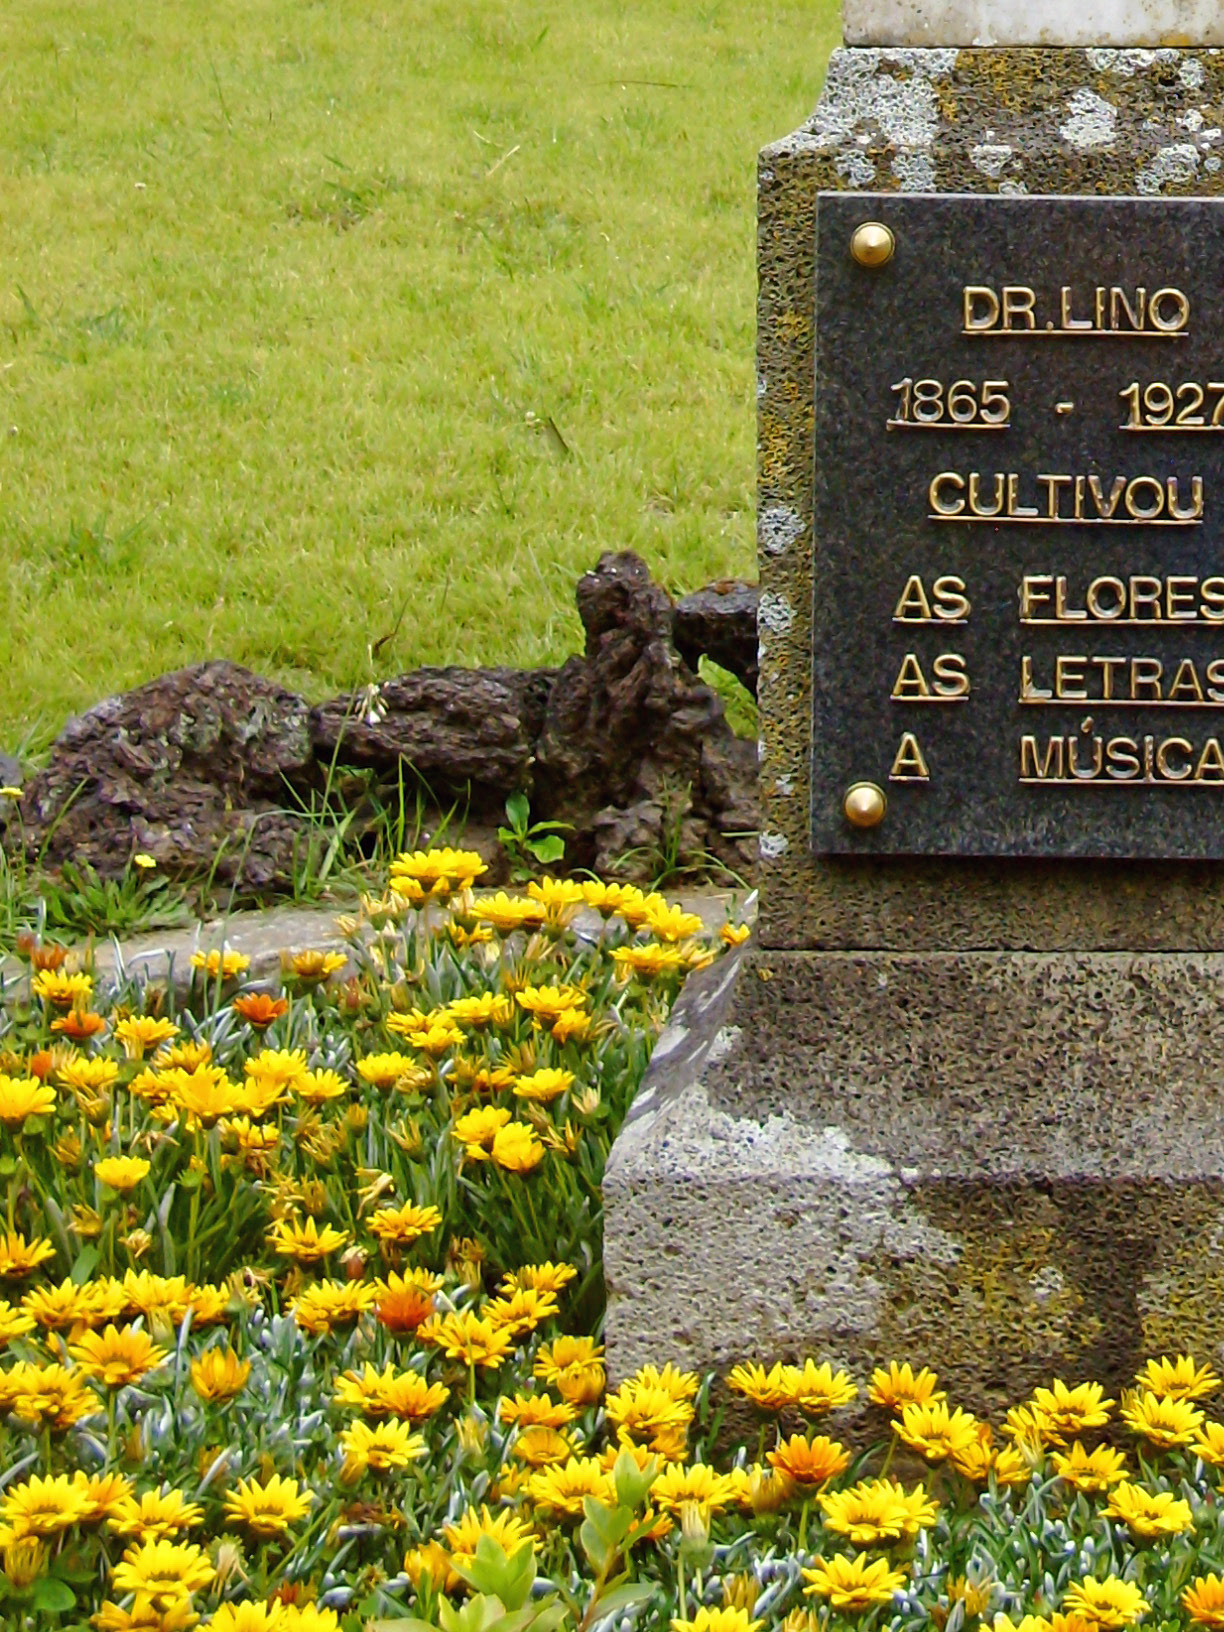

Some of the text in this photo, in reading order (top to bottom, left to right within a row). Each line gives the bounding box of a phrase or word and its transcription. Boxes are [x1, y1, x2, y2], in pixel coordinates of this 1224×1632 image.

[890, 378, 1010, 423] 1865
[929, 472, 1203, 518] CULTIVOU
[895, 575, 970, 619] AS
[893, 654, 969, 698] AS
[891, 732, 929, 777] A
